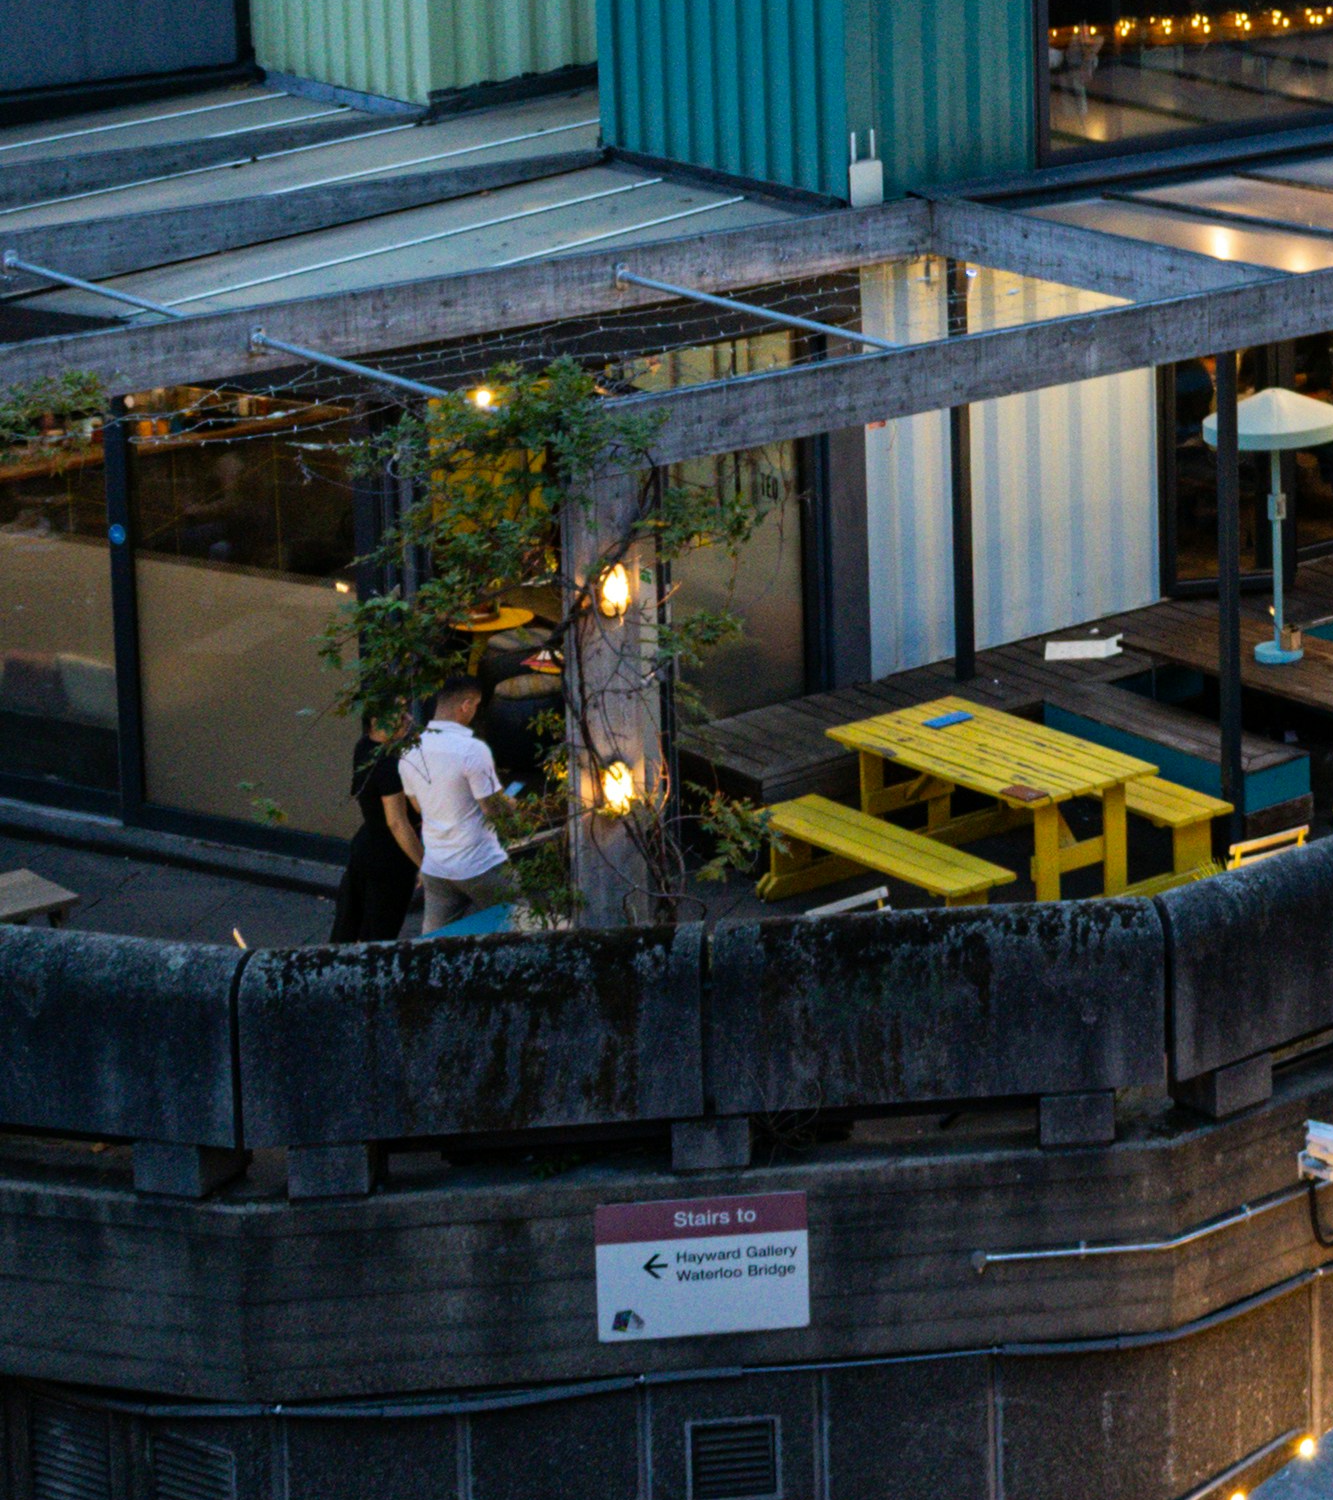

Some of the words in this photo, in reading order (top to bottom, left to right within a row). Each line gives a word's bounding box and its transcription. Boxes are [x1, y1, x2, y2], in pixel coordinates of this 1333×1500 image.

[673, 1209, 730, 1228] Stairs
[736, 1208, 757, 1223] to
[675, 1247, 741, 1264] Hayward
[746, 1245, 797, 1258] Gallery
[676, 1267, 742, 1282] Waterloo
[747, 1264, 796, 1277] Bridge
